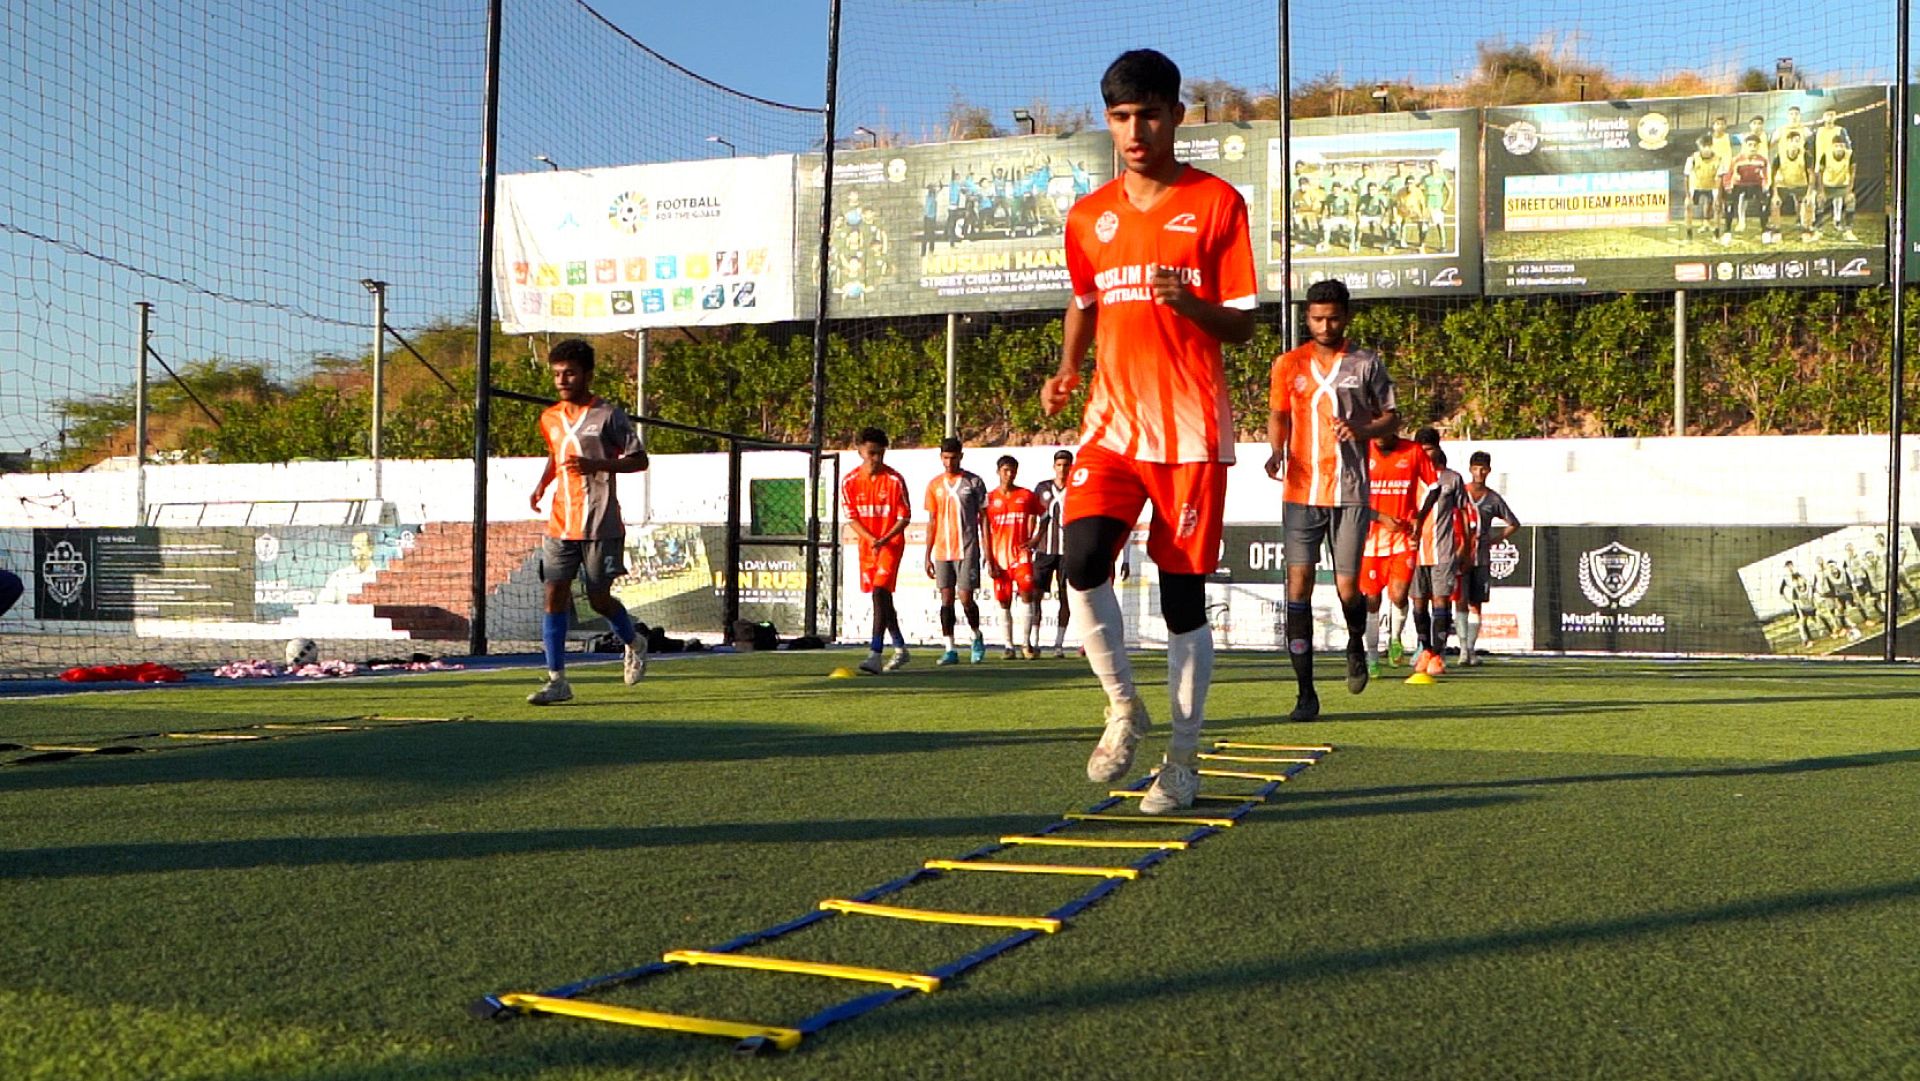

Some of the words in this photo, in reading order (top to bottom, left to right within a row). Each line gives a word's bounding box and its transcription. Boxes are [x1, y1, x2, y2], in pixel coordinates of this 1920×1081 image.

[656, 196, 721, 211] FOOTBALL
[1507, 199, 1545, 212] STREET
[1549, 198, 1580, 211] CHILD
[1583, 196, 1612, 209] TEAM
[1614, 194, 1666, 207] PAKISTAN
[921, 252, 1010, 276] MUSLIM
[1015, 249, 1066, 269] HAN
[919, 276, 964, 288] STREET
[965, 273, 1003, 285] CHILD
[1005, 270, 1036, 283] TEAM
[1071, 468, 1089, 487] 9
[744, 561, 767, 570] DAY
[768, 561, 796, 570] WITH
[715, 570, 753, 589] IN
[1561, 611, 1614, 625] Muslim
[1617, 613, 1665, 626] Hands
